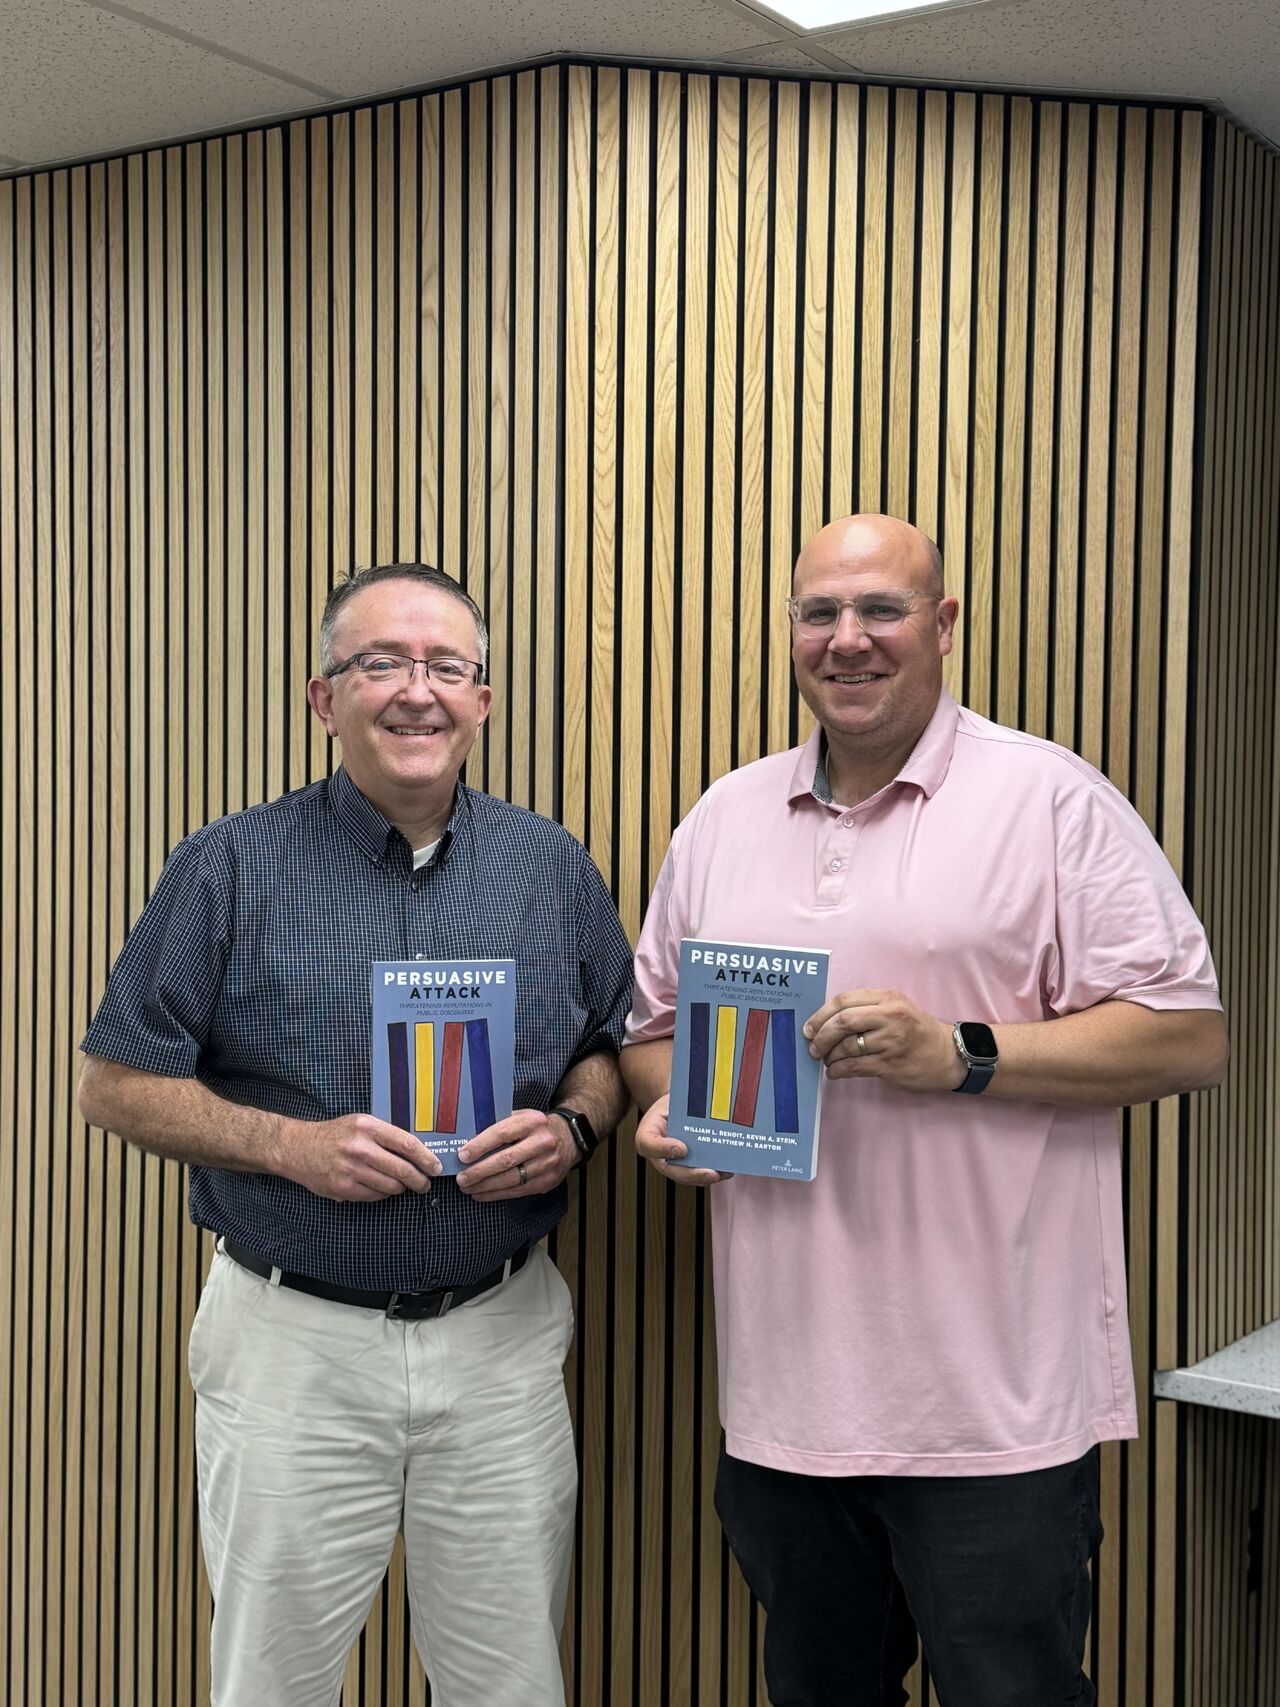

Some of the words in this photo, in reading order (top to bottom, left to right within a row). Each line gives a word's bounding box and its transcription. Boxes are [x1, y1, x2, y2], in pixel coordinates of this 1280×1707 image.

[691, 950, 818, 975] PERSUASIVE
[384, 971, 506, 985] PERSUASIVE
[716, 969, 790, 987] ATTACK
[410, 986, 480, 999] ATTACK
[704, 984, 747, 994] THREATENING
[748, 988, 792, 998] REPUTATIONS
[744, 996, 783, 1004] DISCOURSE
[684, 1126, 710, 1134] WILLIAM
[719, 1130, 744, 1140] BENOIT,
[746, 1134, 766, 1142] KEVIN
[776, 1137, 798, 1146] STEIN,
[712, 1138, 744, 1147] MATTHEW
[754, 1142, 782, 1150] BARTON
